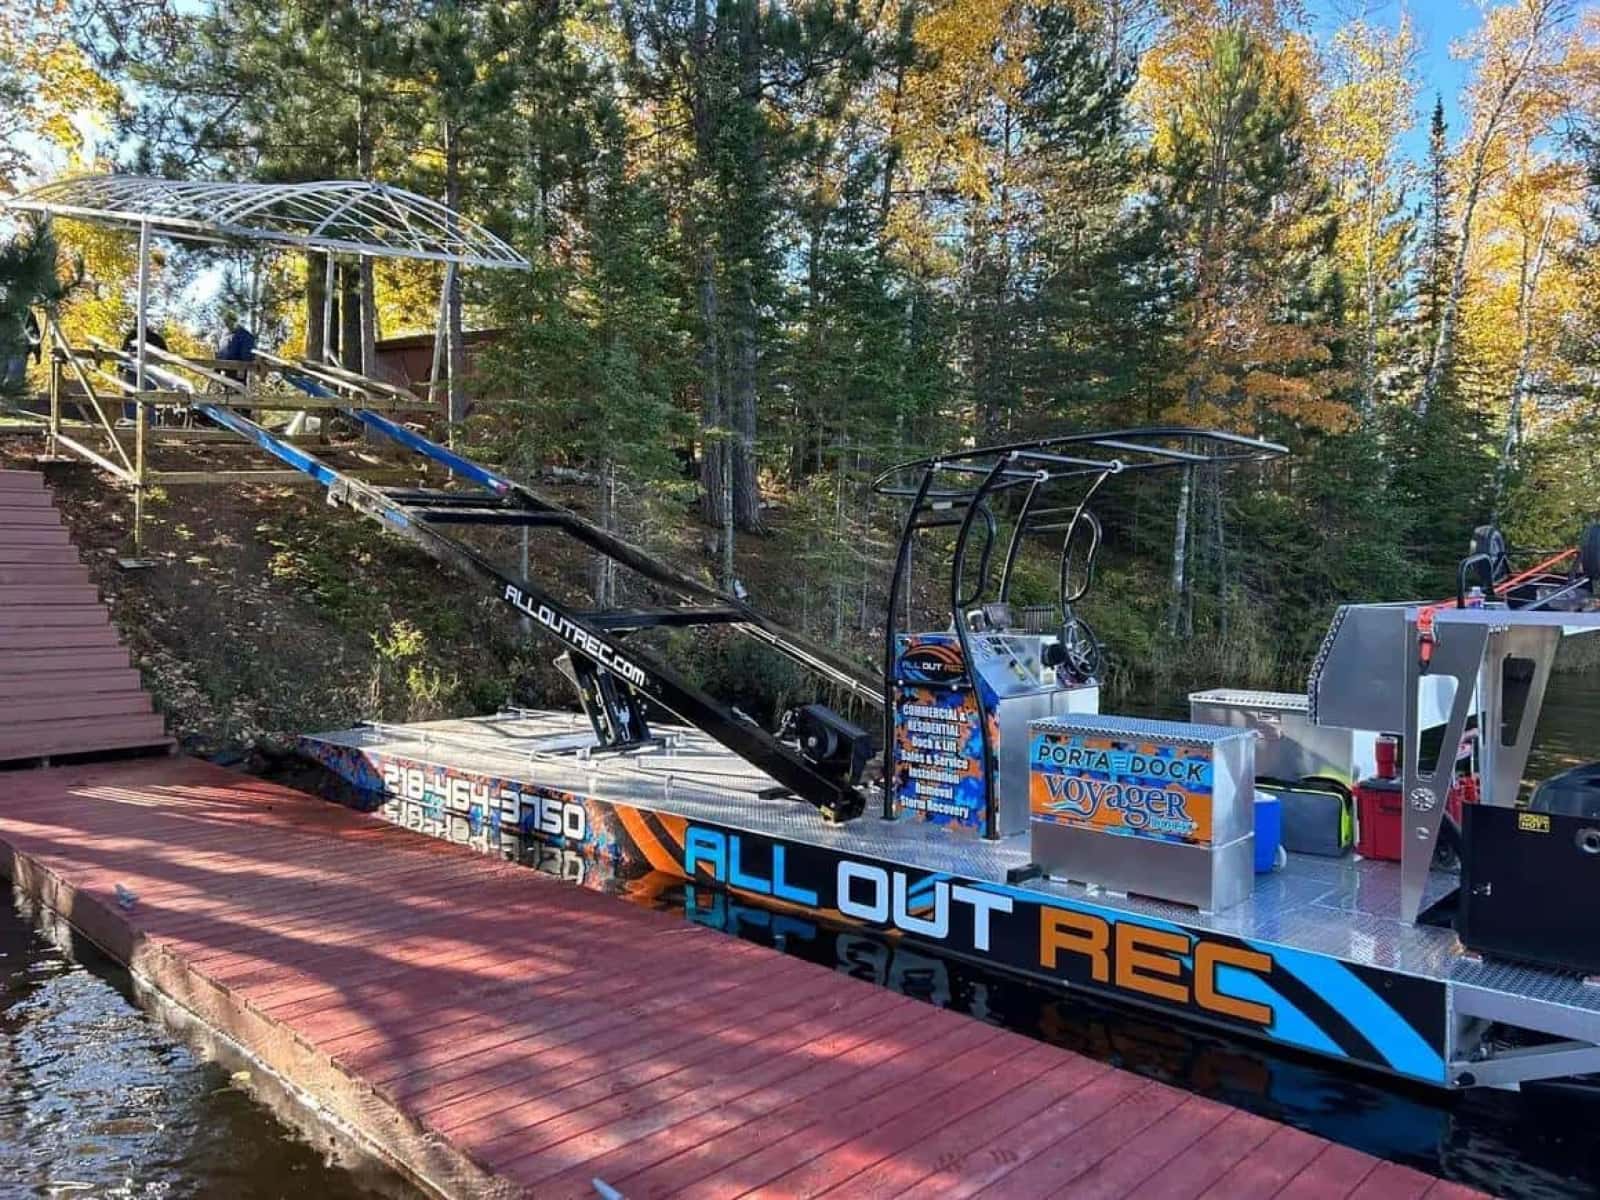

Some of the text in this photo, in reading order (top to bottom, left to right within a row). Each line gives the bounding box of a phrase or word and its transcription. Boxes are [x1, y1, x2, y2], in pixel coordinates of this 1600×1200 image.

[922, 661, 943, 672] OUT
[902, 704, 958, 721] COMMERCIAL
[907, 718, 961, 737] RESIDENTIAL
[911, 735, 958, 753] Dock & Lift
[900, 749, 969, 770] Sales & Service
[1037, 744, 1207, 781] PORTA DOCK
[908, 765, 960, 785] Installation
[915, 781, 953, 799] Removal
[384, 764, 586, 841] 218-464-3750
[900, 794, 969, 819] Storm Recovery
[683, 826, 1273, 1026] ALL OUT REC
